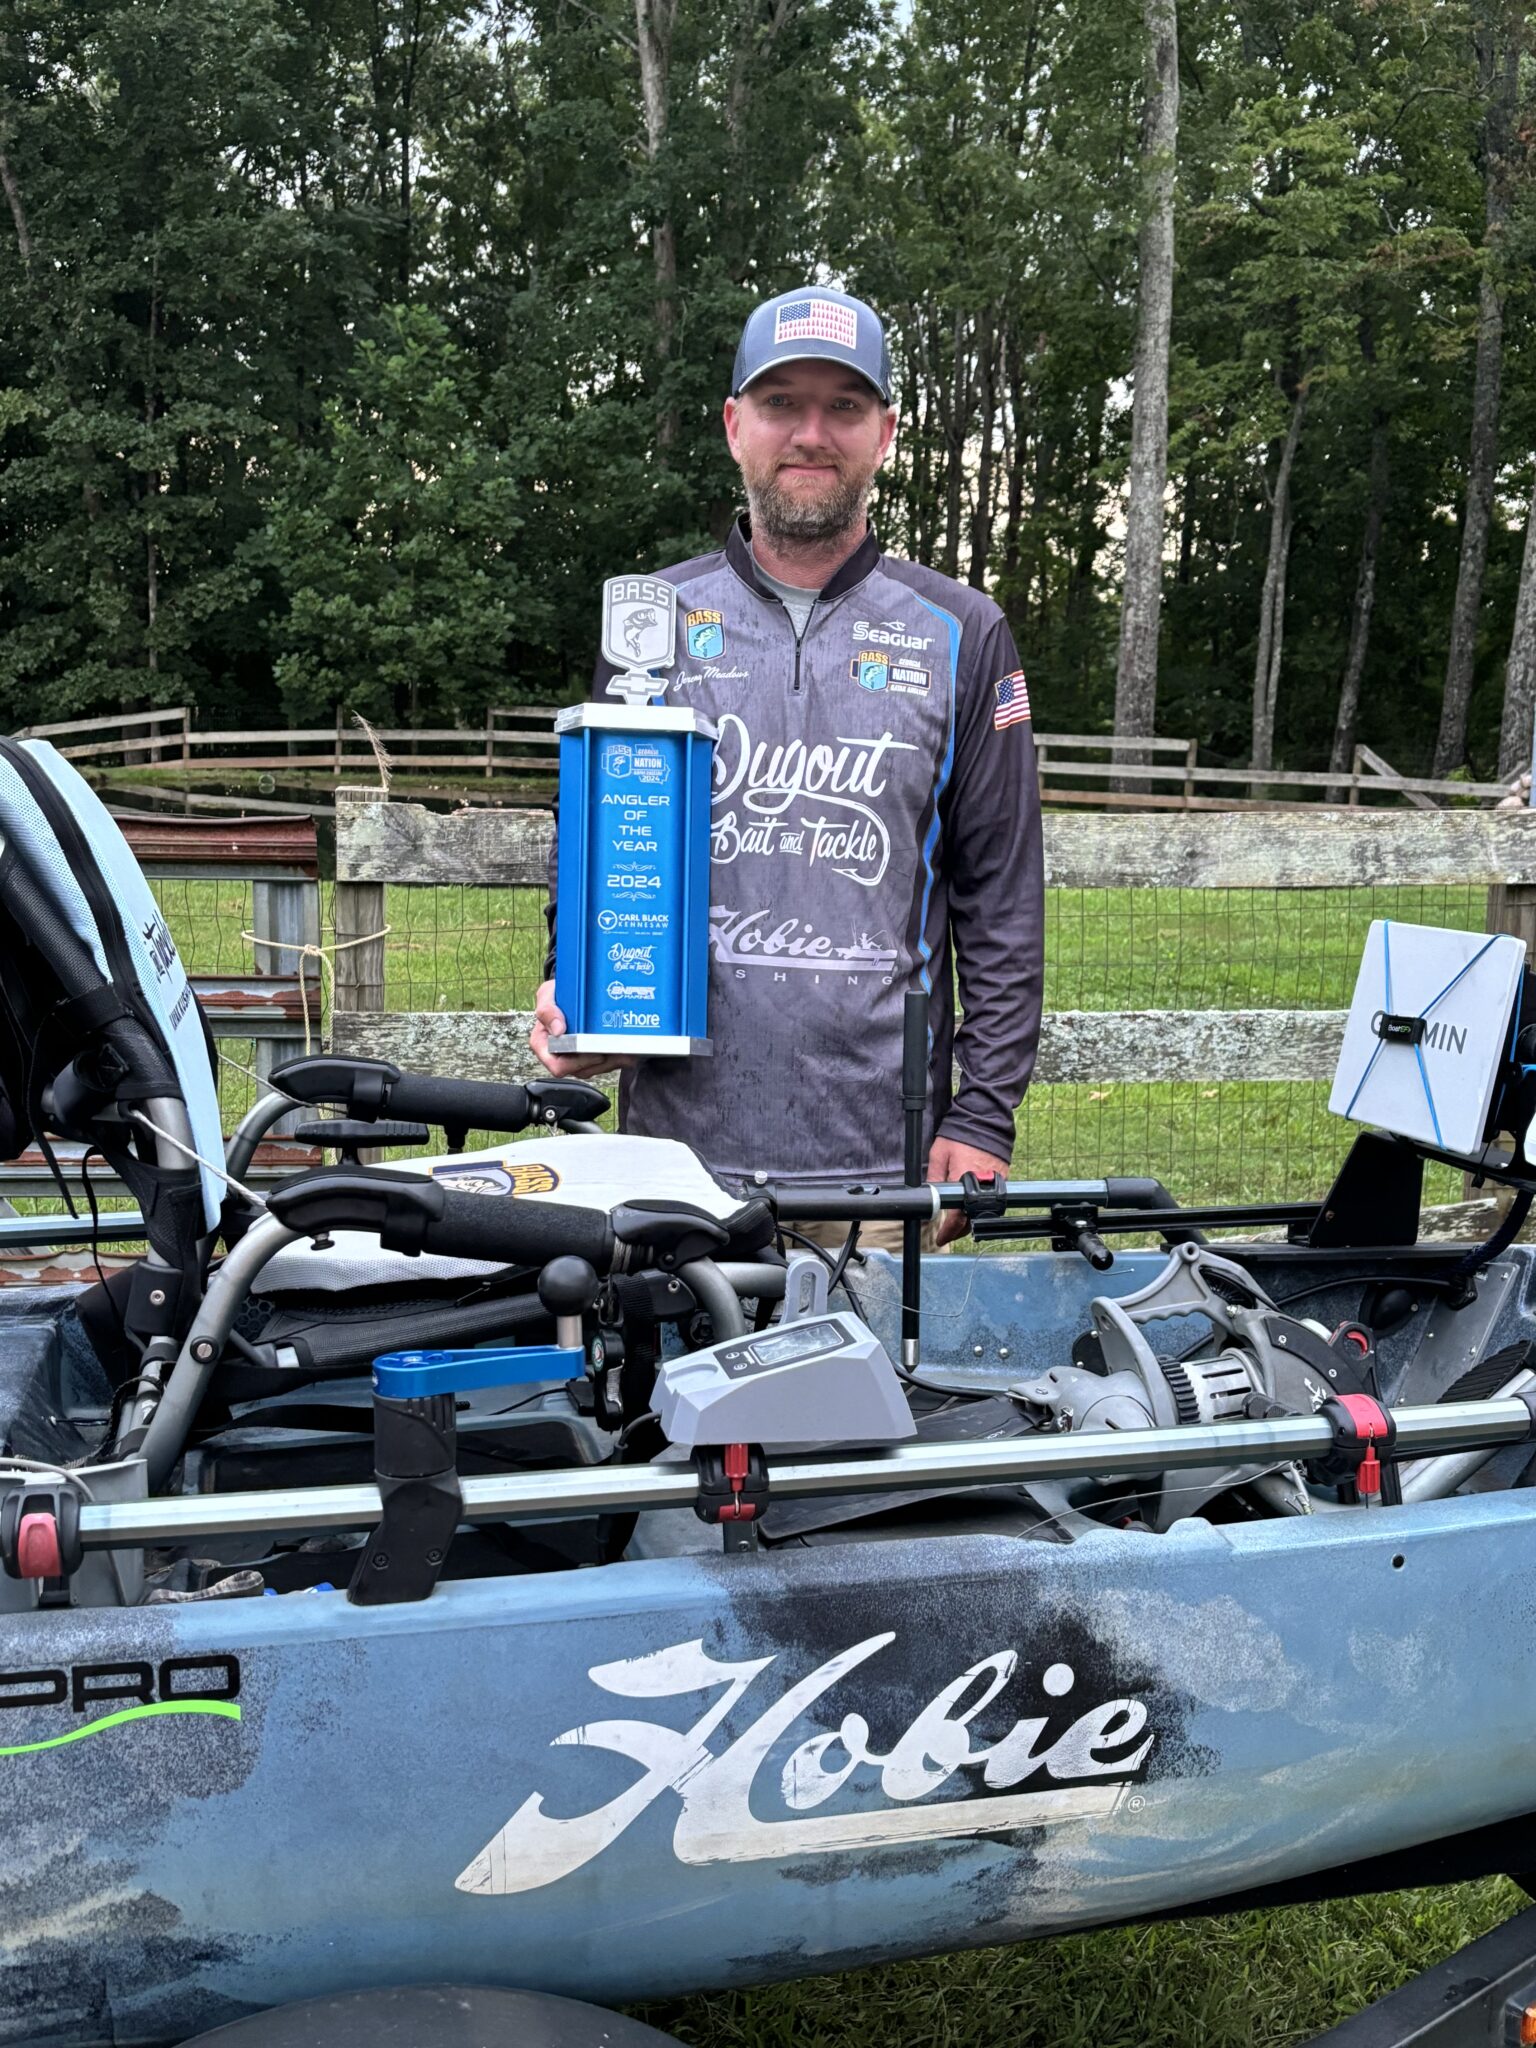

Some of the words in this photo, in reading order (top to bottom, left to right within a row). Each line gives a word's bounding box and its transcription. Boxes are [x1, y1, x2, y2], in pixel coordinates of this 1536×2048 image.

[687, 610, 722, 627] BASS
[853, 621, 932, 651] Seaguar
[861, 652, 888, 665] BASS
[703, 666, 750, 679] Meadows
[892, 668, 927, 686] NATION
[608, 746, 630, 755] BASS
[634, 758, 662, 768] NATION
[711, 714, 919, 814] Dugout
[601, 794, 670, 806] ANGLER
[624, 810, 647, 821] OF
[618, 825, 652, 836] THE
[612, 840, 657, 851] YEAR
[711, 811, 788, 864] Bait
[780, 831, 804, 855] and
[800, 816, 877, 867] Tackle
[607, 875, 661, 888] 2024
[642, 914, 669, 922] BLACK
[709, 905, 865, 970] Hobie
[608, 942, 657, 962] Dugout
[736, 968, 893, 986] SHING
[1371, 1010, 1467, 1054] GMIN
[455, 1630, 1154, 1895] Hobie
